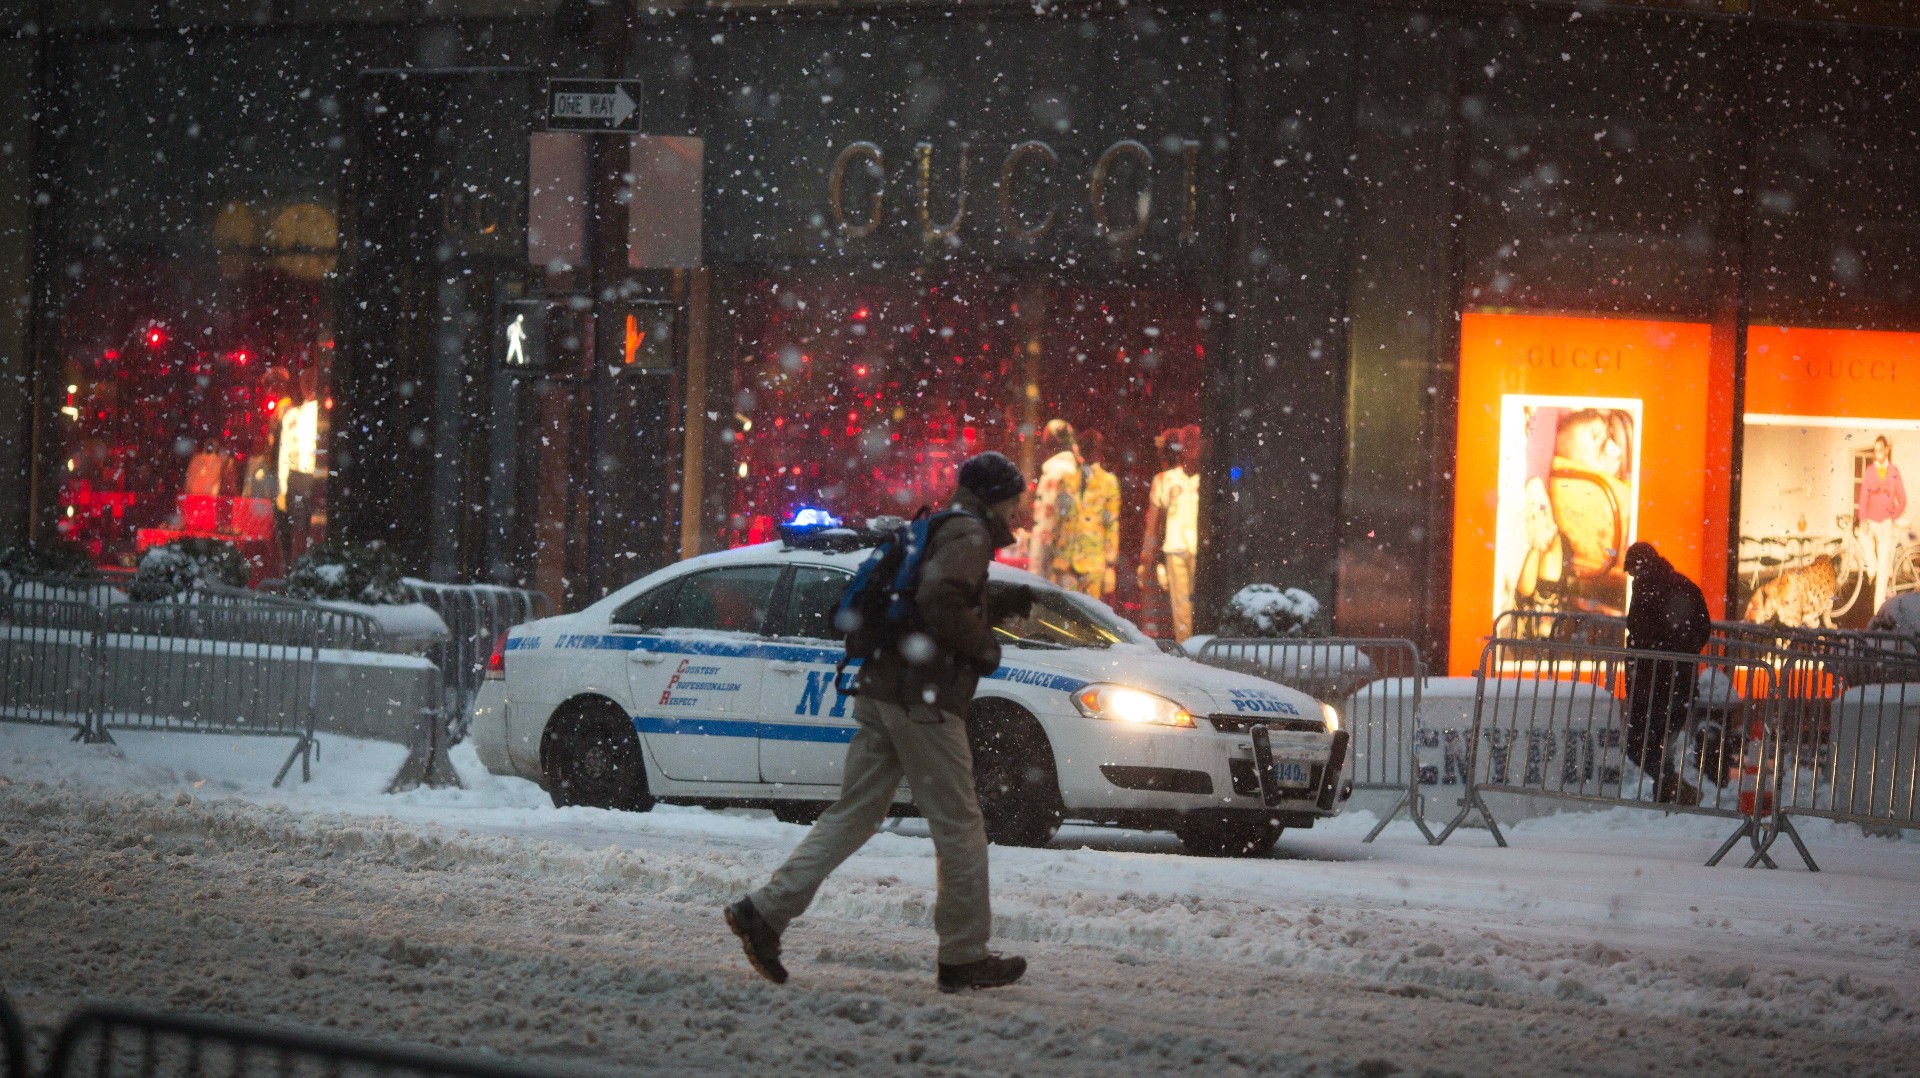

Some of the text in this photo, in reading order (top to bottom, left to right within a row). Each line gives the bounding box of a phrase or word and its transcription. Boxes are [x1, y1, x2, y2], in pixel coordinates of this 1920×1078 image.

[558, 95, 616, 115] ONE WAY
[829, 139, 1201, 242] GUCCI
[1527, 345, 1622, 371] GUCCI
[1805, 358, 1897, 382] GUCCI
[1007, 668, 1053, 688] POLICE
[795, 671, 858, 718] NY
[1231, 699, 1299, 716] POLICE
